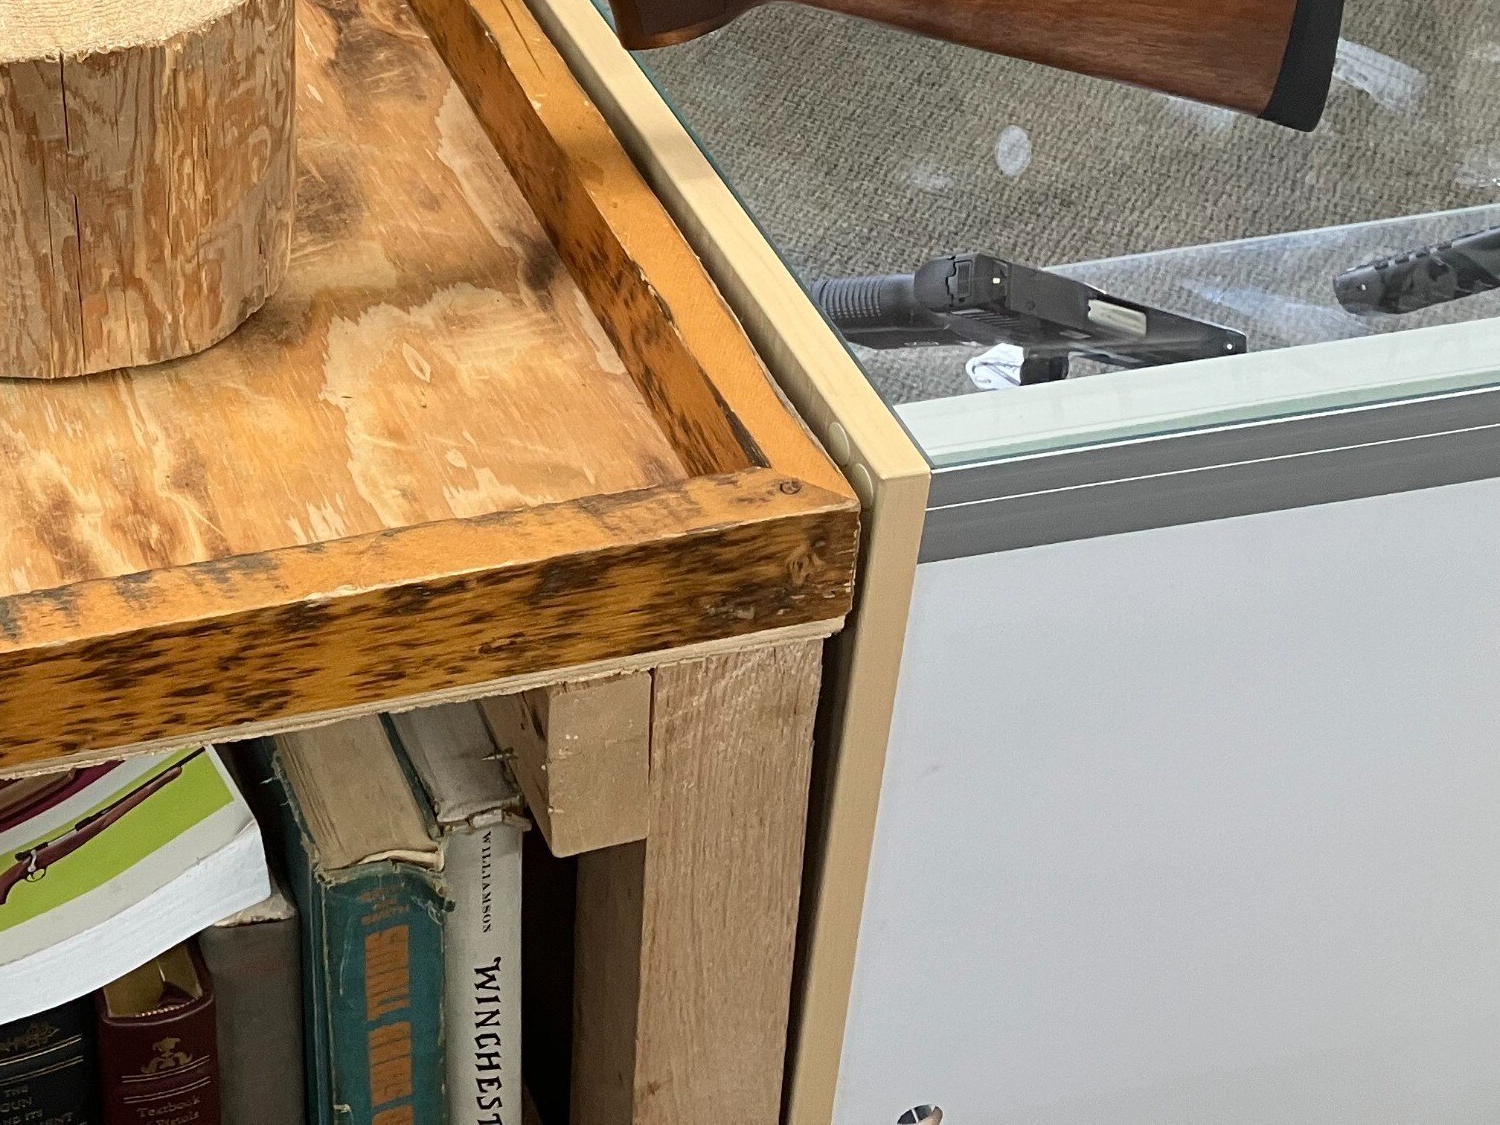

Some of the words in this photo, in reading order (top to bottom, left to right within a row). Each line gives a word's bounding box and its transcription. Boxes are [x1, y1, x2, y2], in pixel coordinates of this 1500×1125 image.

[481, 830, 493, 934] WILLIAMSON
[3, 1083, 30, 1099] THE
[0, 1097, 34, 1114] GUN
[136, 1095, 202, 1119] Textbook
